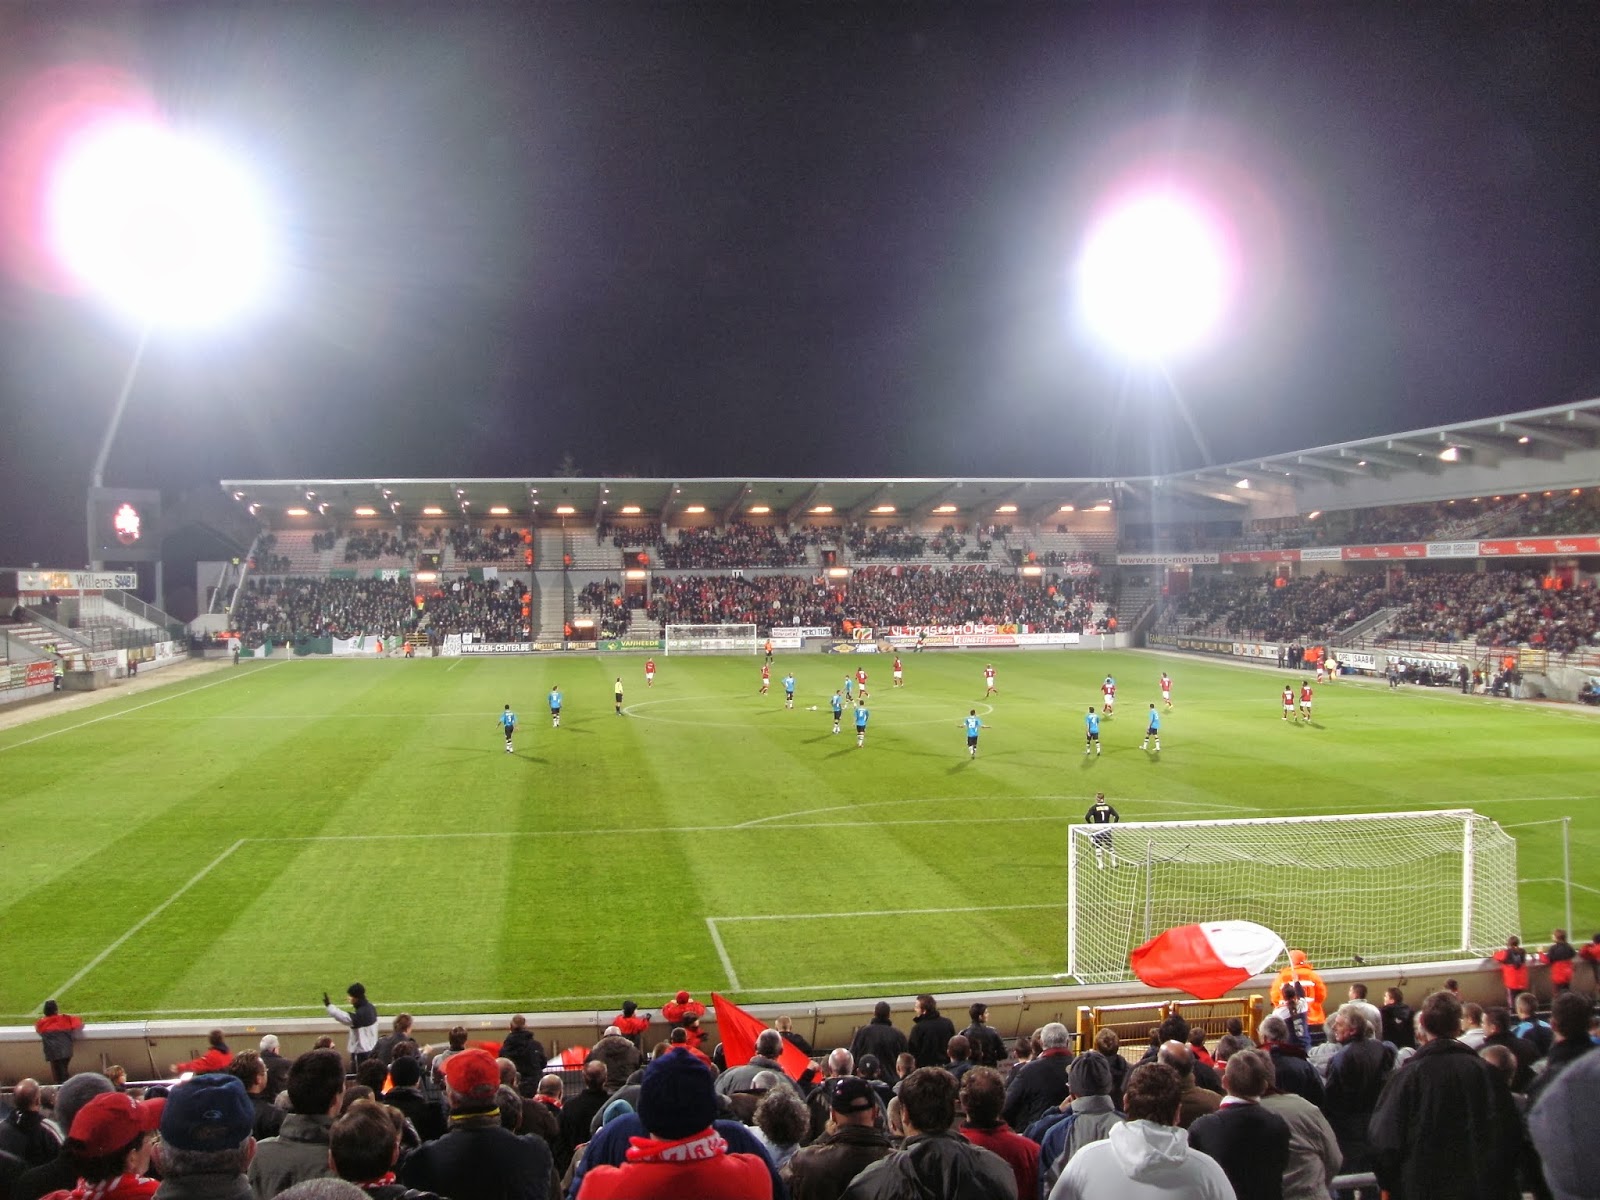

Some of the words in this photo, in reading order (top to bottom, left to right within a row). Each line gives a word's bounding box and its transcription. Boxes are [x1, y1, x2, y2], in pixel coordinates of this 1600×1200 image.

[77, 574, 112, 588] Willems
[1339, 653, 1351, 662] OPEL
[1354, 655, 1369, 664] SAAB
[1101, 811, 1105, 821] 1
